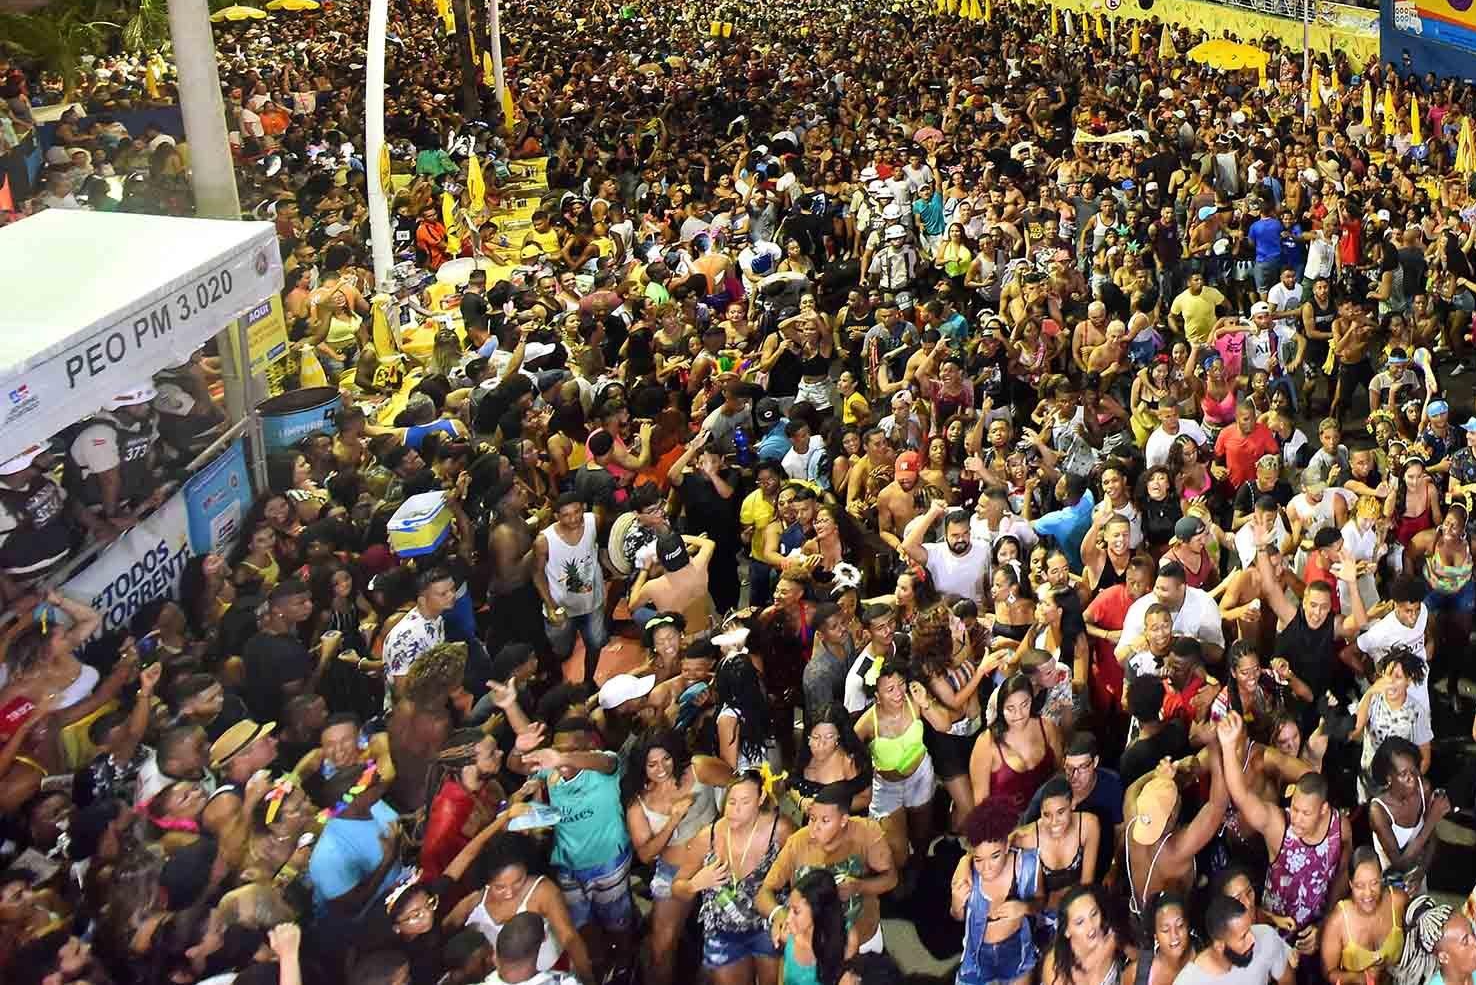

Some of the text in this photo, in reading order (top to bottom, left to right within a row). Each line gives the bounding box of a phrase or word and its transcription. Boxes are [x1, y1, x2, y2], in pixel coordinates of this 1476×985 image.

[65, 269, 233, 389] PEO PM 3.020
[90, 539, 170, 611] #TODOS
